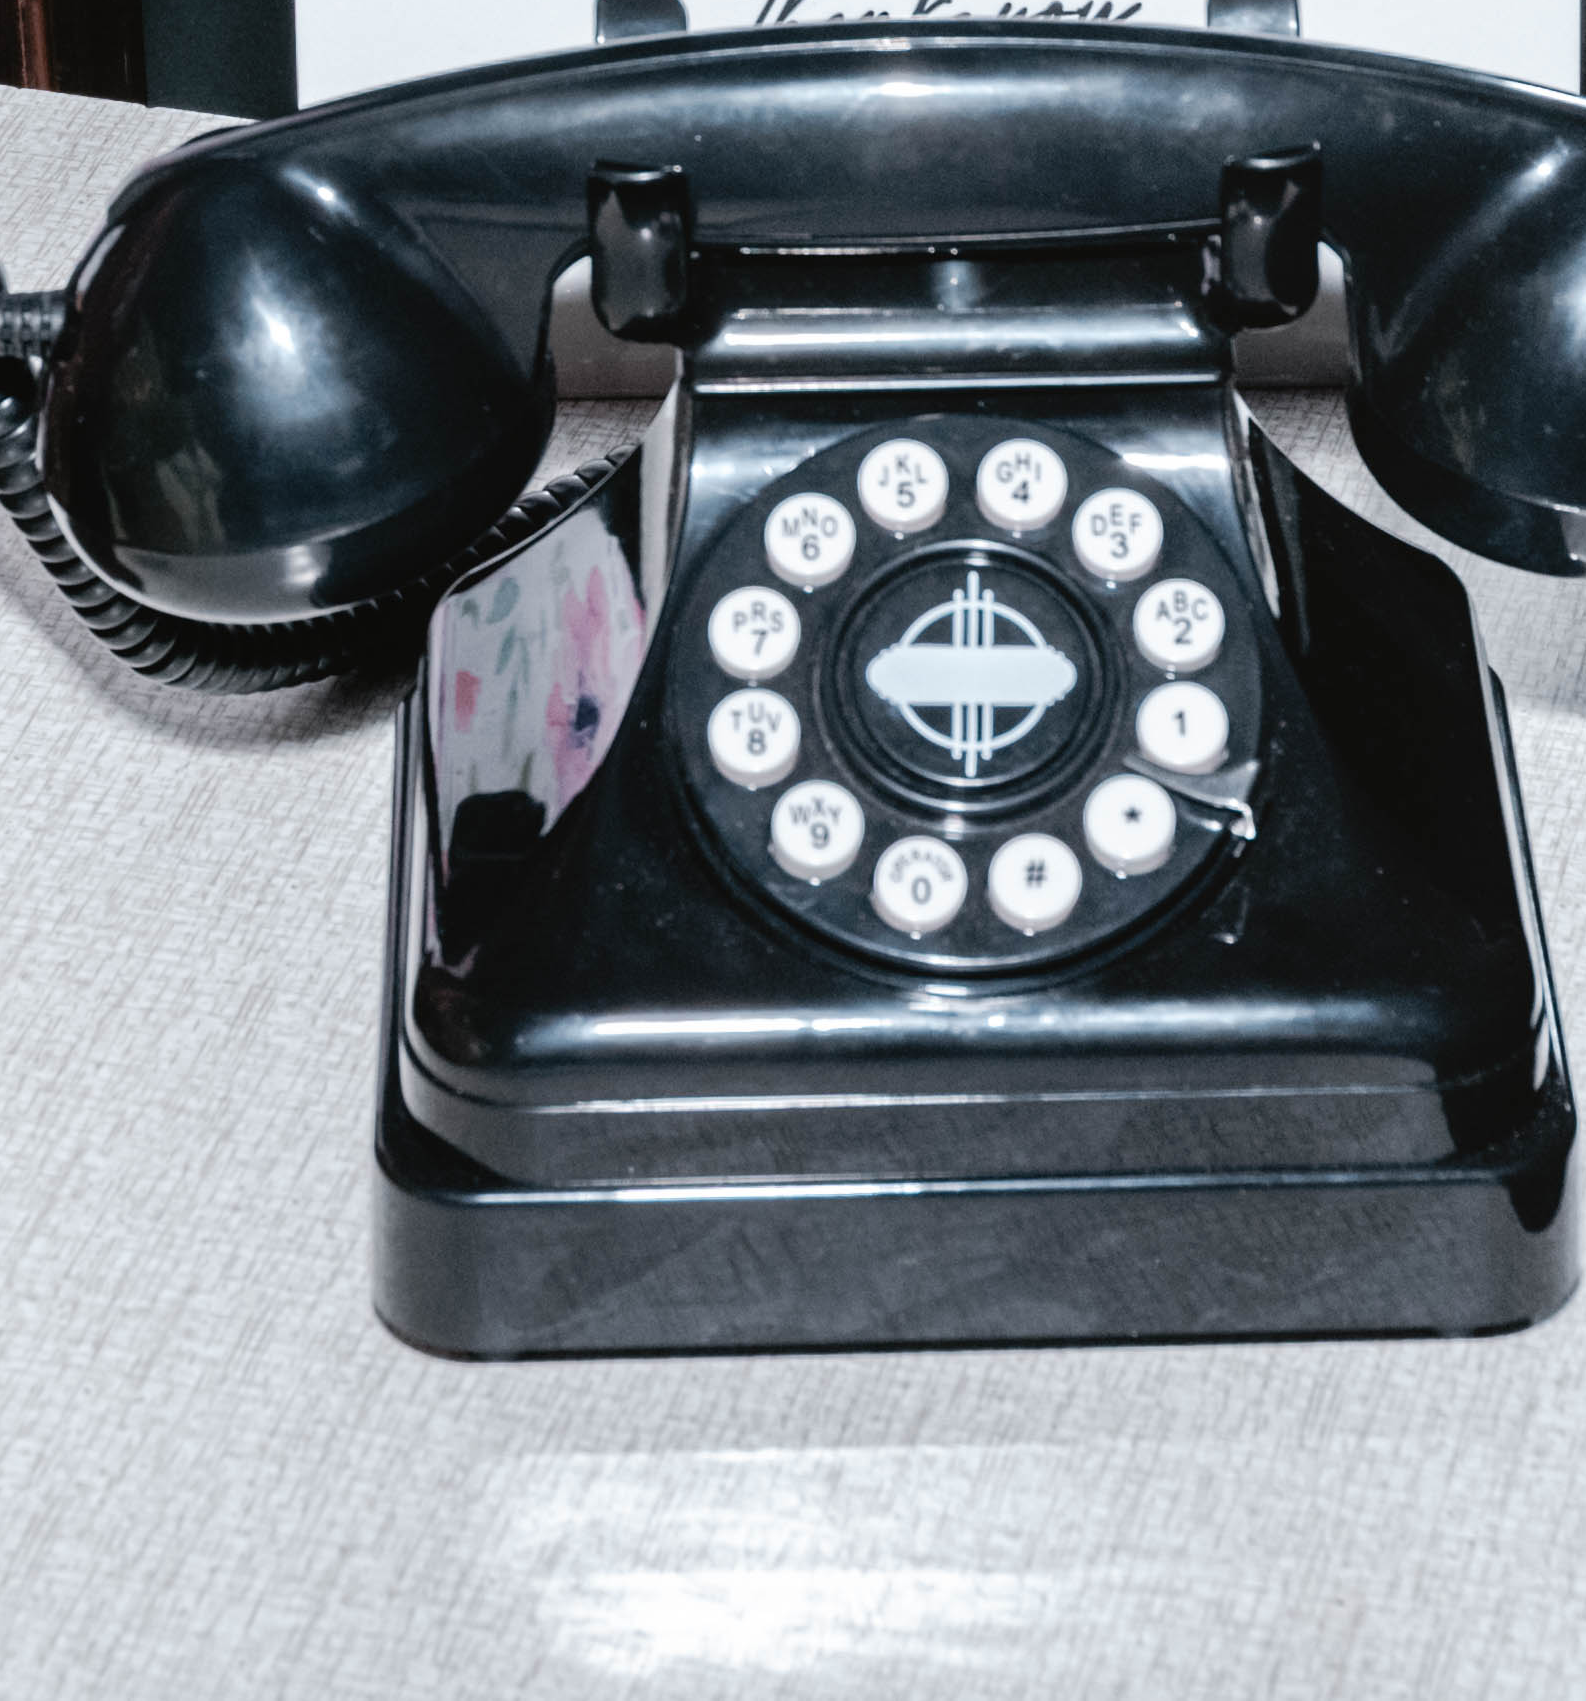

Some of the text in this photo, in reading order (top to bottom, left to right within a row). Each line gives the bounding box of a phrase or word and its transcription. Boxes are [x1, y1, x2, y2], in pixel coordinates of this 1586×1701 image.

[879, 454, 928, 487] JKL
[995, 453, 1042, 486] GHI
[896, 482, 916, 508] 5
[1011, 480, 1032, 504] 4
[782, 508, 839, 540] MNO
[1091, 504, 1144, 538] DEF
[800, 535, 821, 561] 6
[1110, 532, 1130, 558] 3
[732, 602, 785, 634] PRS
[1155, 591, 1209, 623] ABC
[751, 630, 769, 655] 7
[1174, 618, 1193, 645] 2
[731, 702, 782, 734] TUV
[1172, 709, 1188, 736] 1
[746, 729, 767, 755] 8
[790, 798, 842, 828] WXY
[810, 823, 831, 849] 9
[910, 876, 932, 904] 0
